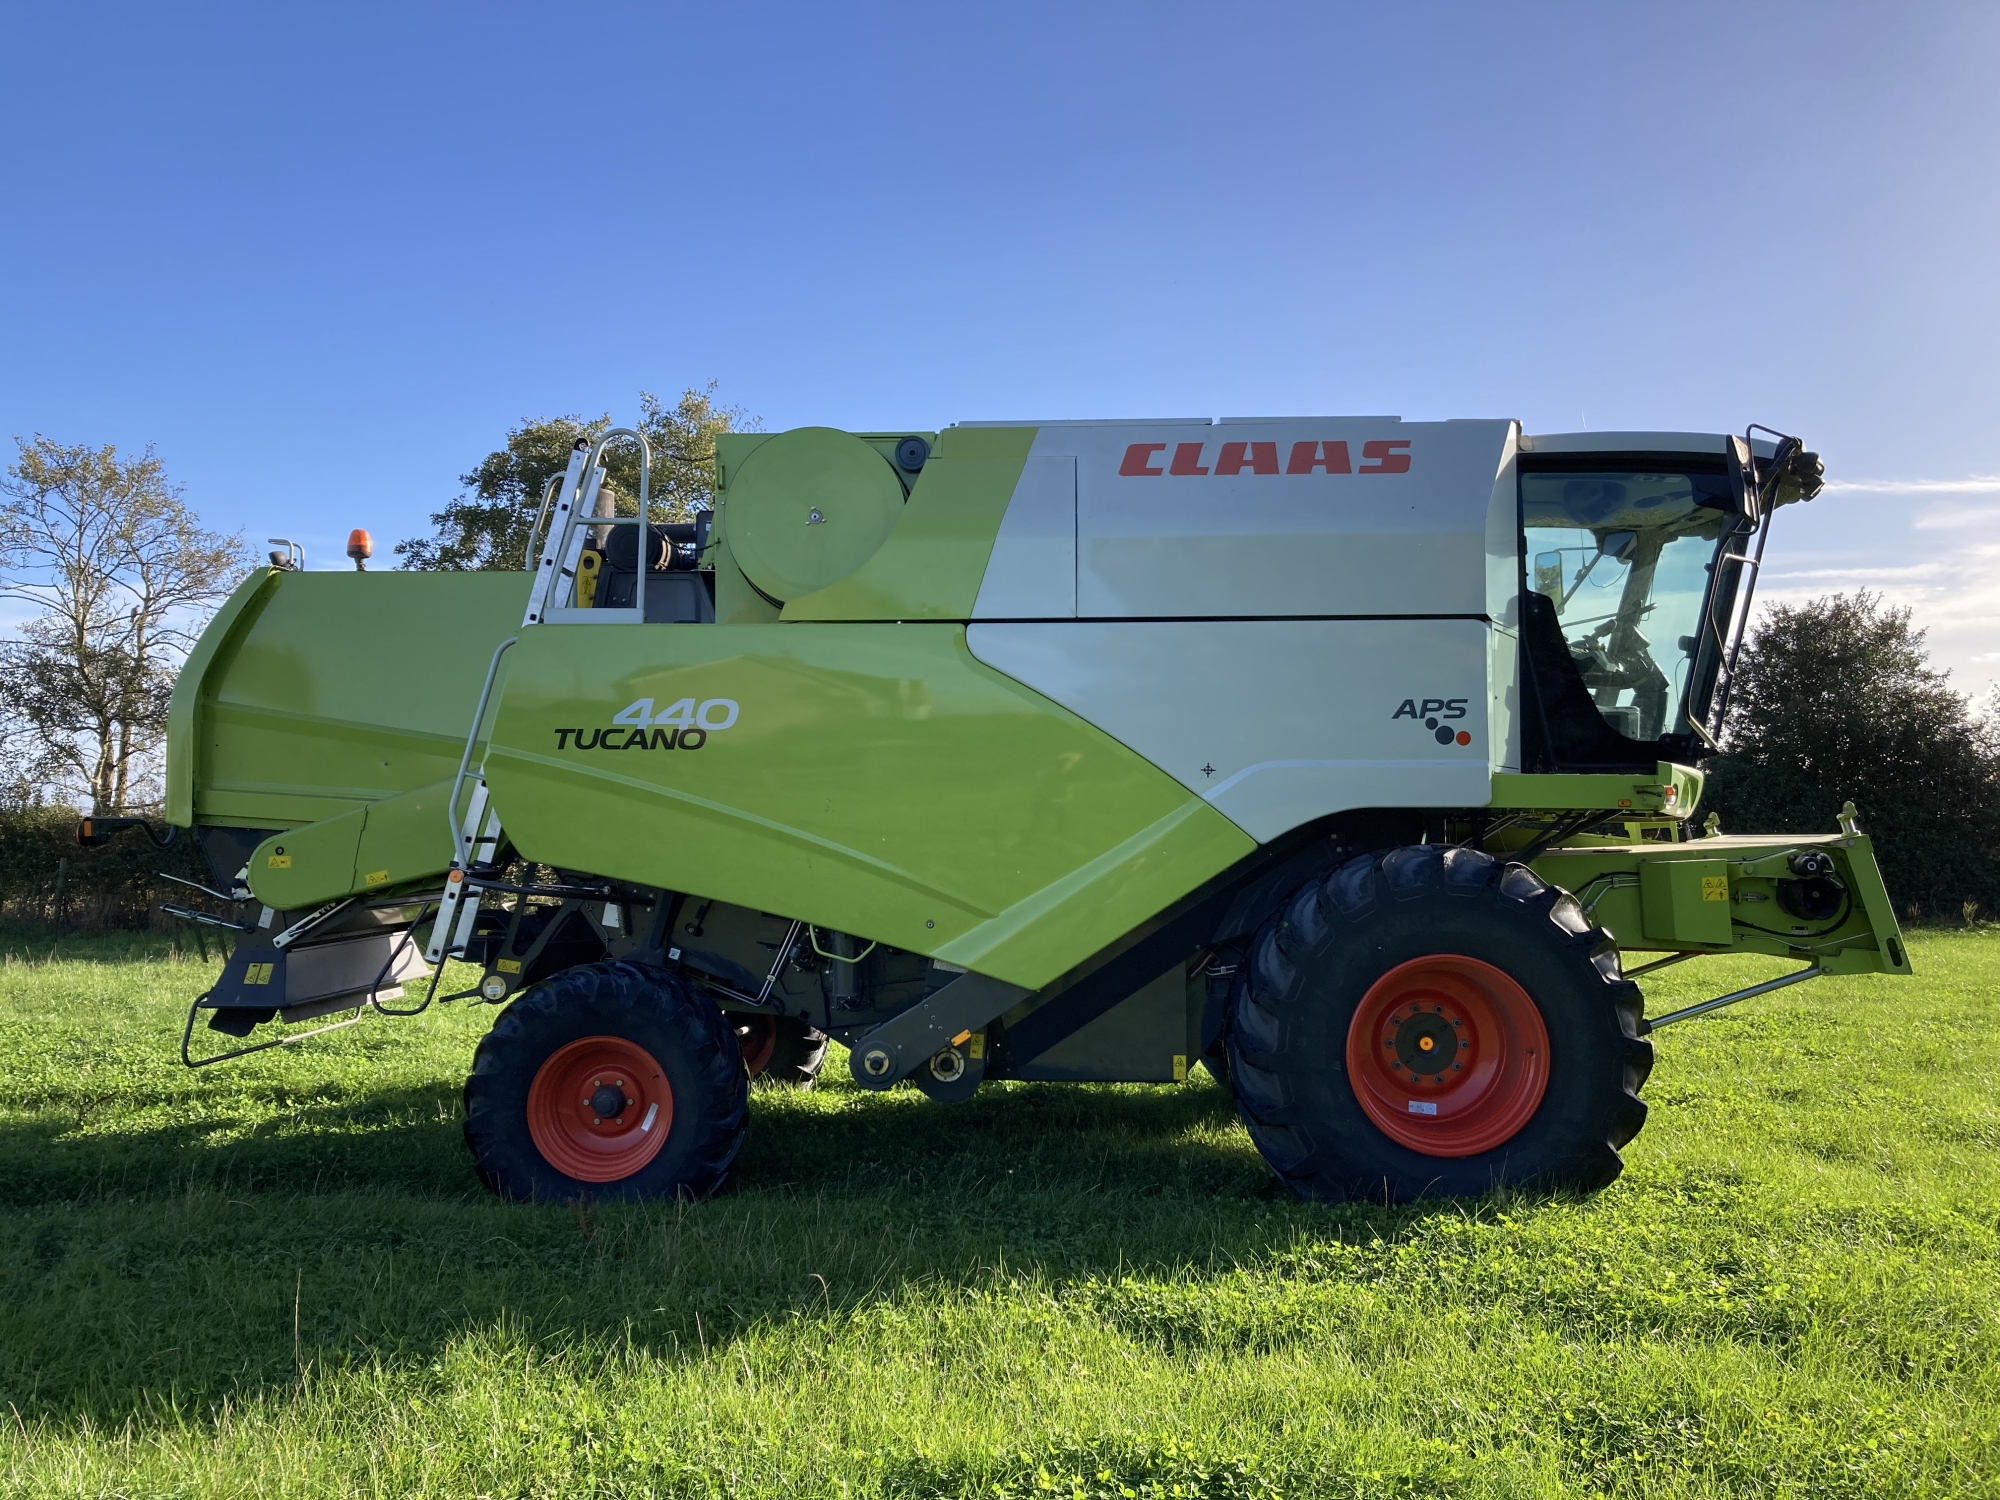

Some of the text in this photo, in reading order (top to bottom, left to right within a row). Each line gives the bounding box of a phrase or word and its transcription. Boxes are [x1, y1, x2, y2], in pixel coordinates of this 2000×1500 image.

[1118, 440, 1412, 477] CLAAS
[612, 697, 740, 731] 440
[1391, 698, 1469, 720] APS
[554, 728, 707, 751] TUCANO
